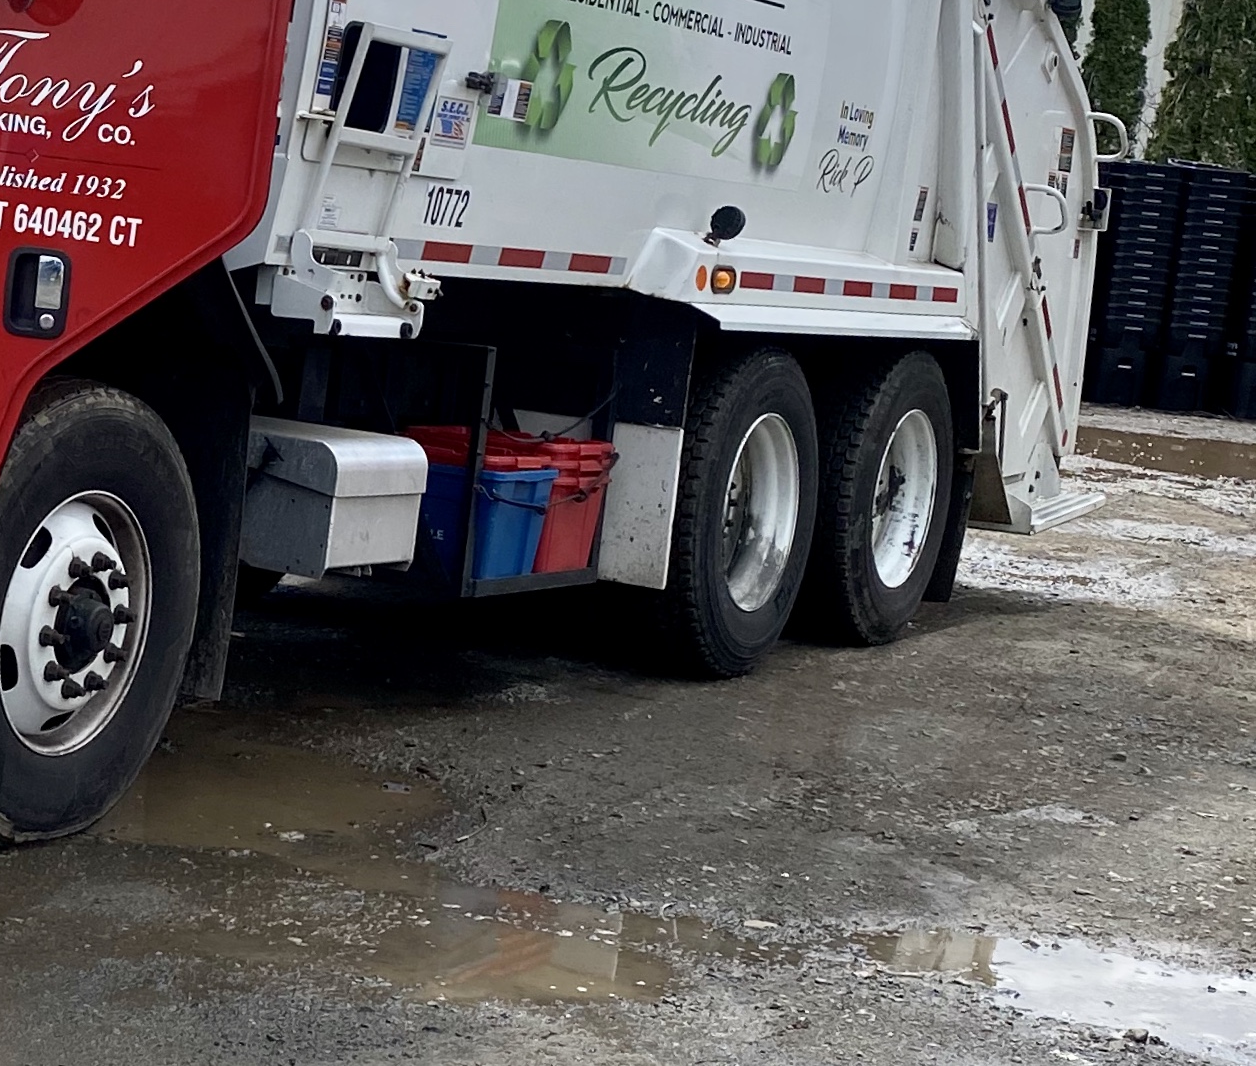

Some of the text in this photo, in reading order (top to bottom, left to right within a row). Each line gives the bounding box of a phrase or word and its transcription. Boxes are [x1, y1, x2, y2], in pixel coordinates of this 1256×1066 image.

[653, 1, 724, 38] COMMERCIAL
[734, 22, 792, 55] INDUSTRIAL
[587, 46, 752, 158] Recycling
[839, 100, 875, 129] In Loving
[97, 124, 136, 146] CO.
[837, 124, 870, 152] Memory
[70, 174, 127, 200] 1932
[816, 148, 875, 198] Rick P
[13, 203, 102, 243] 640462
[109, 215, 143, 247] CT
[423, 186, 471, 228] 10772
